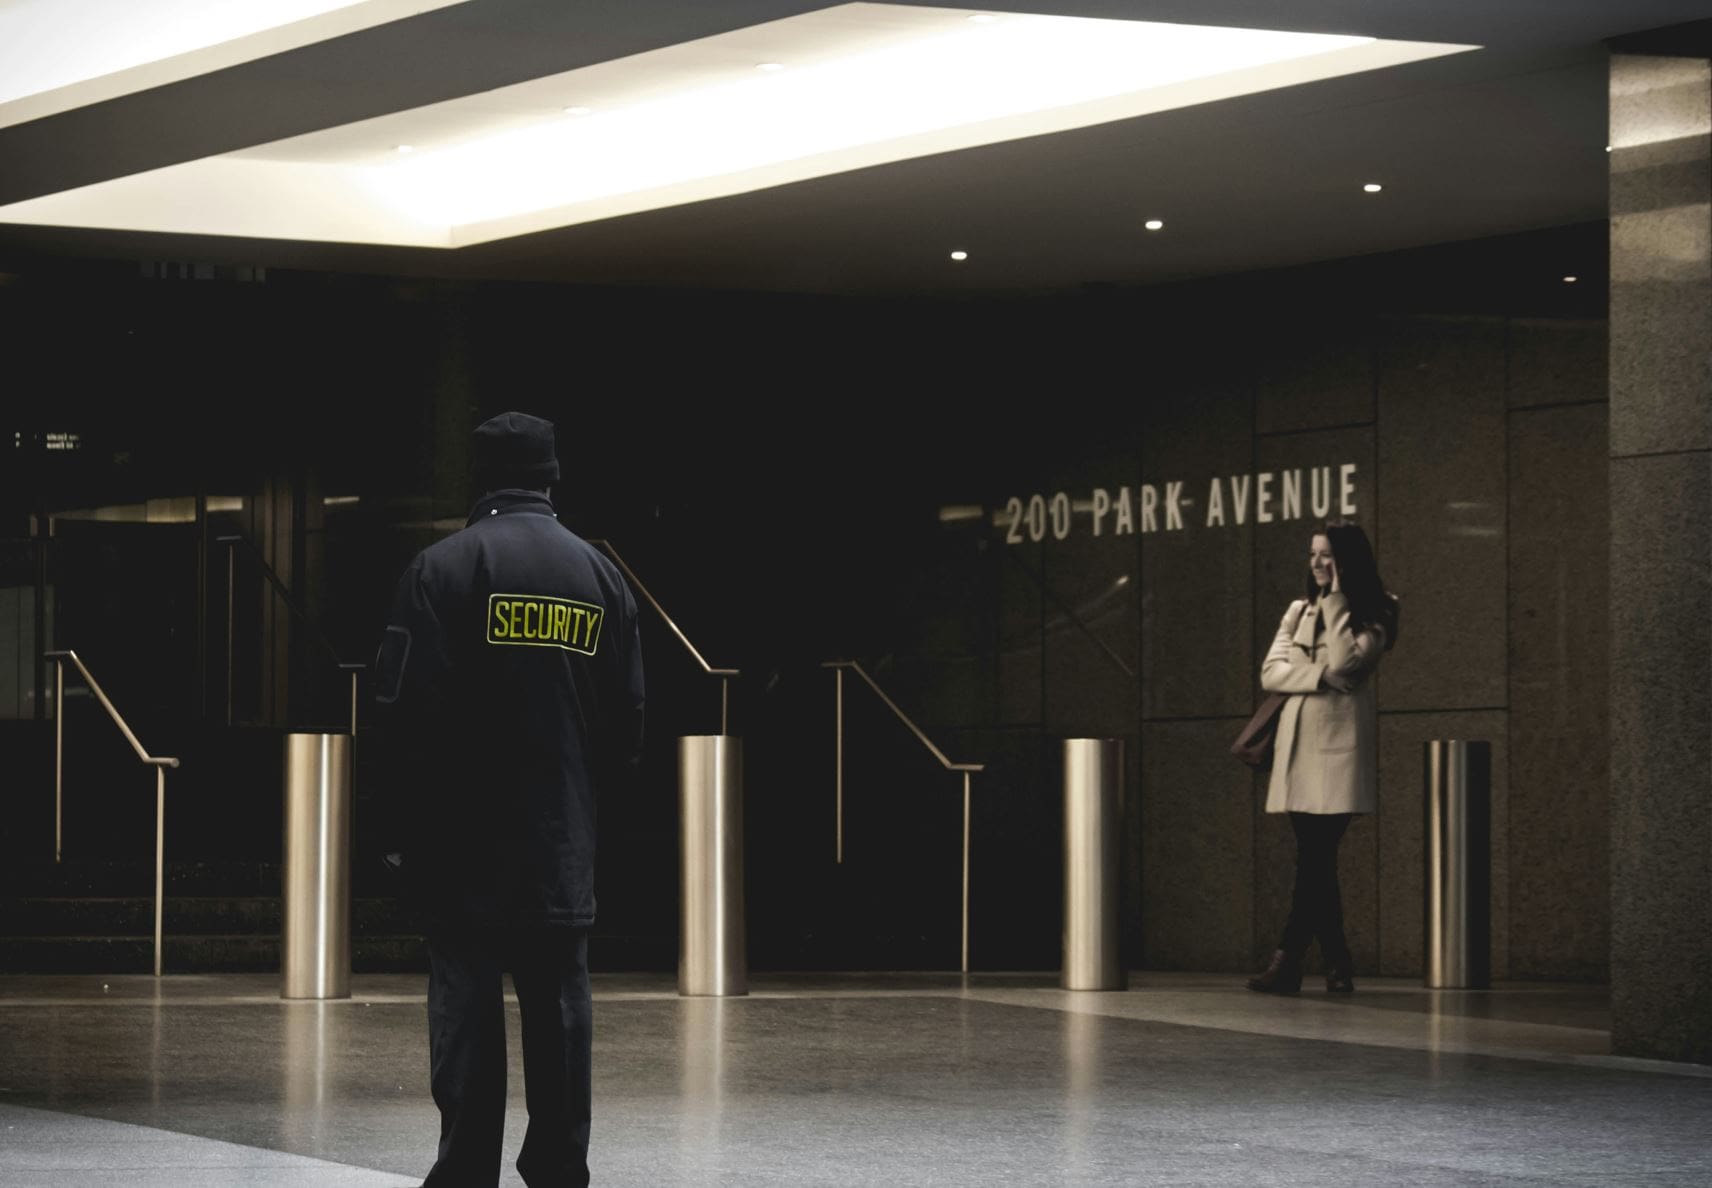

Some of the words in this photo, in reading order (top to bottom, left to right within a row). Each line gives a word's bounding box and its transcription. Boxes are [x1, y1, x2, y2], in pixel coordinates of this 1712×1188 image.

[1006, 491, 1071, 544] 200
[1092, 481, 1184, 536] PARK
[1206, 463, 1357, 528] AVENUE
[494, 600, 599, 648] SECURITY
